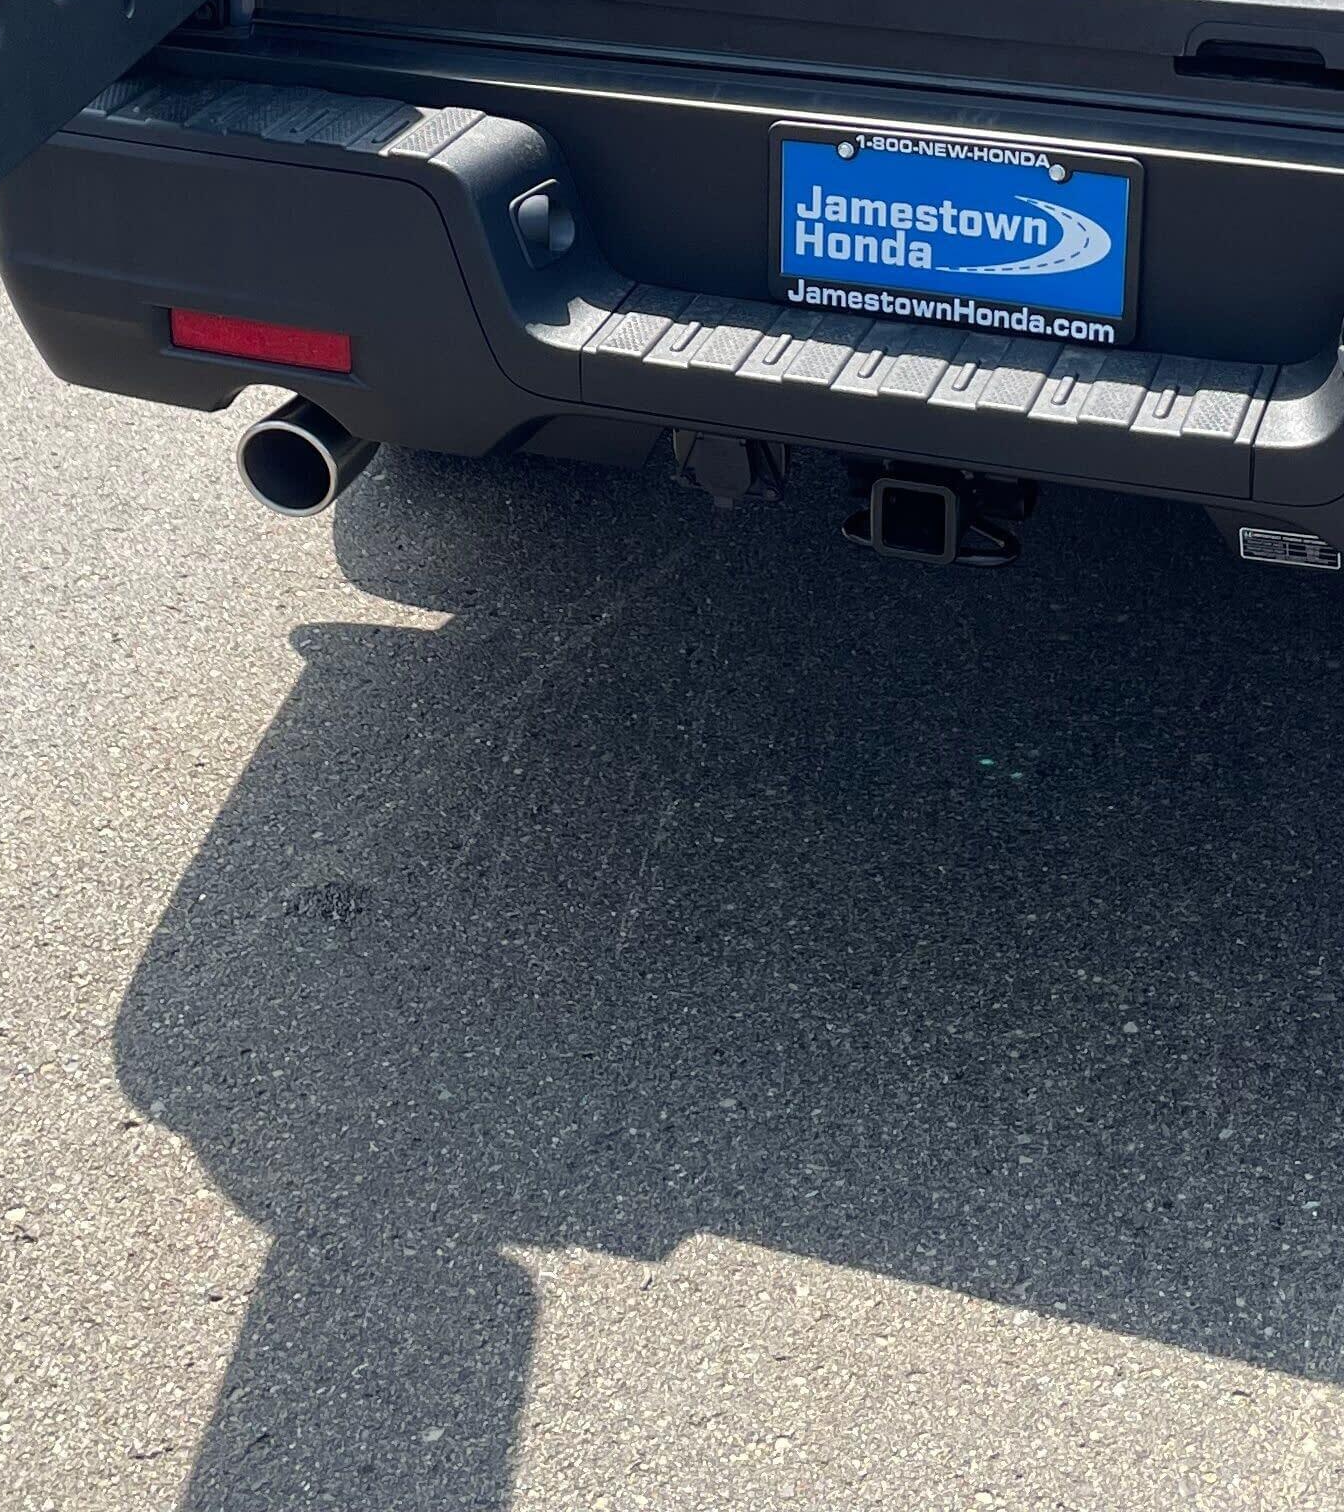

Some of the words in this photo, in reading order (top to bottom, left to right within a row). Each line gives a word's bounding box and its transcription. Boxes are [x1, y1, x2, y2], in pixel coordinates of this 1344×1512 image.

[856, 134, 1050, 168] 1-800-NEW-HONDA
[797, 185, 1047, 245] Jamestown
[796, 221, 932, 269] Honda
[787, 279, 1115, 343] JamestownHonda.com
